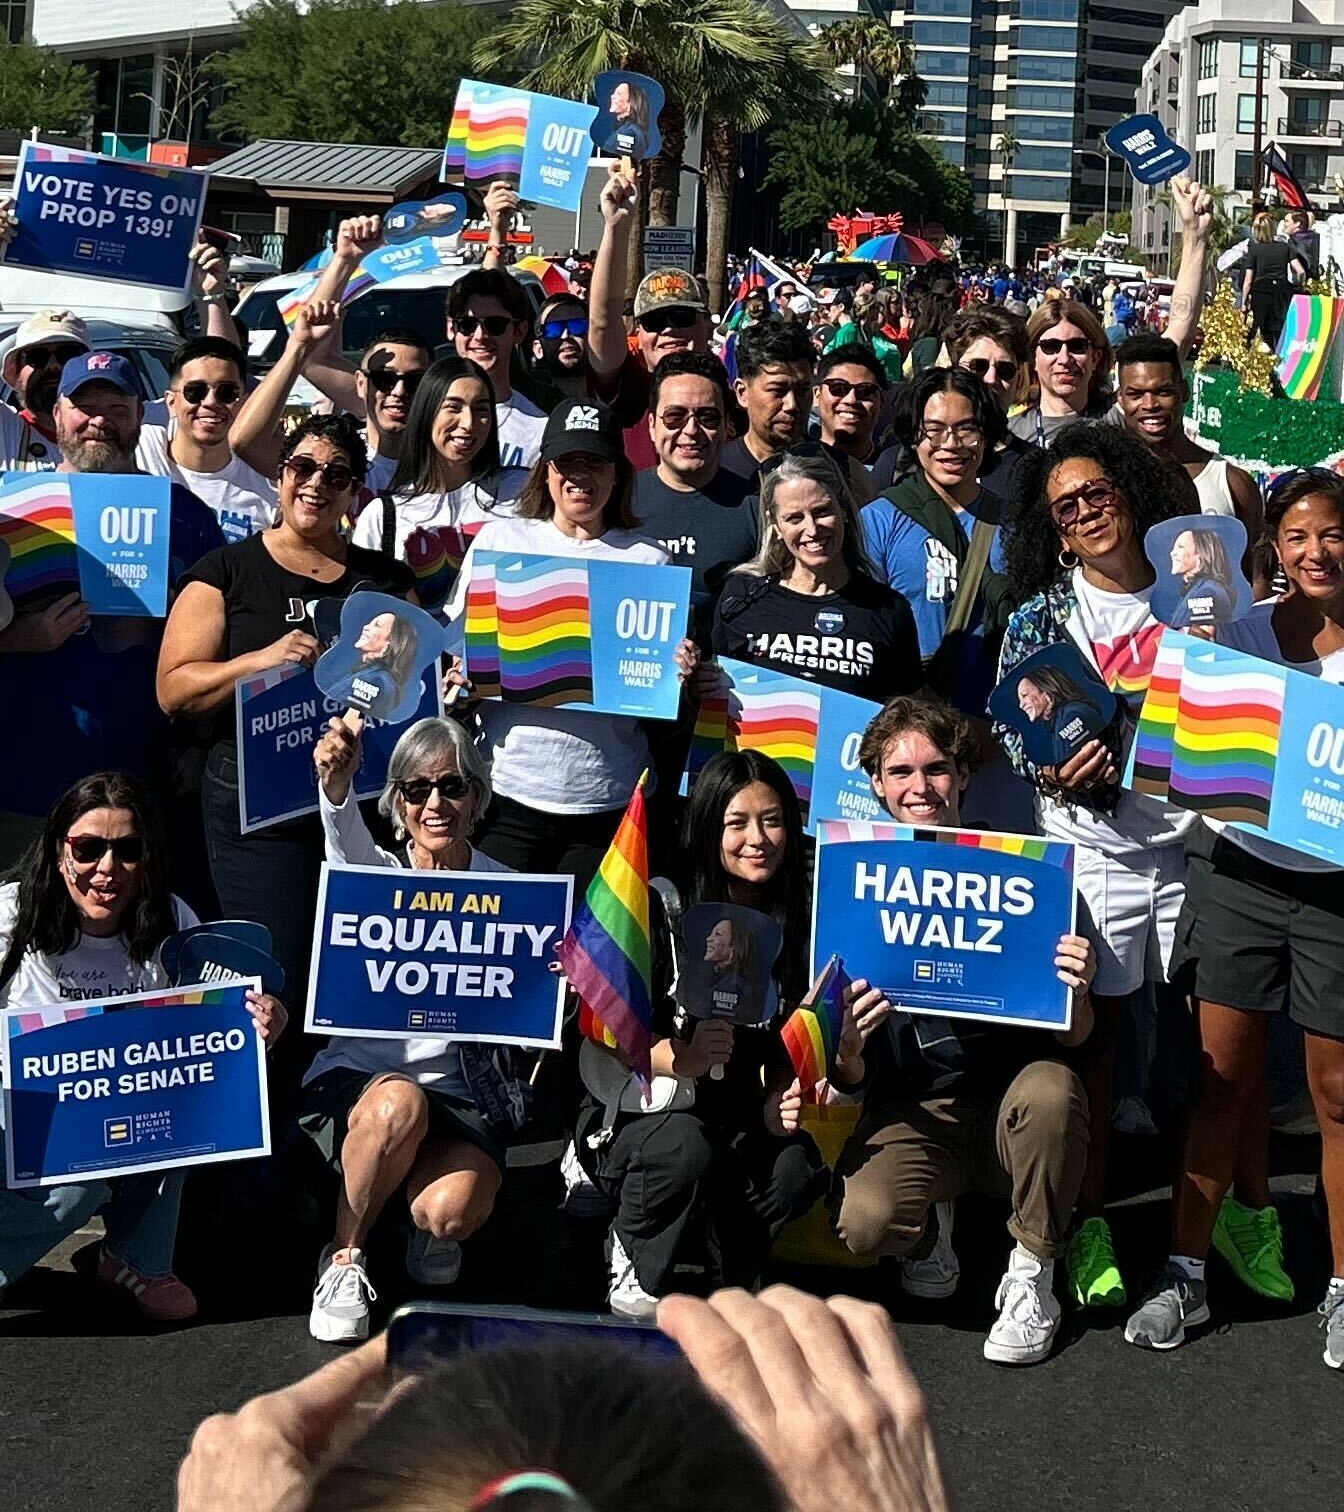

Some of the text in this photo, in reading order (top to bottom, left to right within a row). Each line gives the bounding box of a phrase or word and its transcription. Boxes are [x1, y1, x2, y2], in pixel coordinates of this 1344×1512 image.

[543, 122, 587, 158] OUT
[25, 171, 197, 217] VOTE YES ON
[40, 200, 174, 238] PROP 139!
[566, 405, 599, 422] AZ
[100, 506, 158, 545] OUT
[106, 563, 148, 580] HARRIS
[112, 579, 141, 588] WALZ
[616, 598, 676, 642] OUT
[746, 633, 874, 664] HARRIS
[619, 659, 662, 679] HARRIS
[624, 675, 655, 688] WALZ
[251, 697, 316, 736] RUBEN
[276, 729, 314, 752] FOR
[837, 790, 880, 815] HARRIS
[841, 807, 871, 821] WALZ
[1306, 808, 1343, 829] WALZ
[393, 890, 501, 915] I AM AN
[855, 862, 1034, 916] HARRIS
[329, 913, 556, 957] EQUALITY
[880, 909, 1004, 954] WALZ
[59, 985, 102, 1000] brave
[365, 959, 515, 998] VOTER
[23, 1028, 245, 1079] RUBEN GALLEGO
[58, 1062, 215, 1103] FOR SENATE
[135, 1110, 171, 1121] HUMAN
[135, 1118, 171, 1129] RIGHTS
